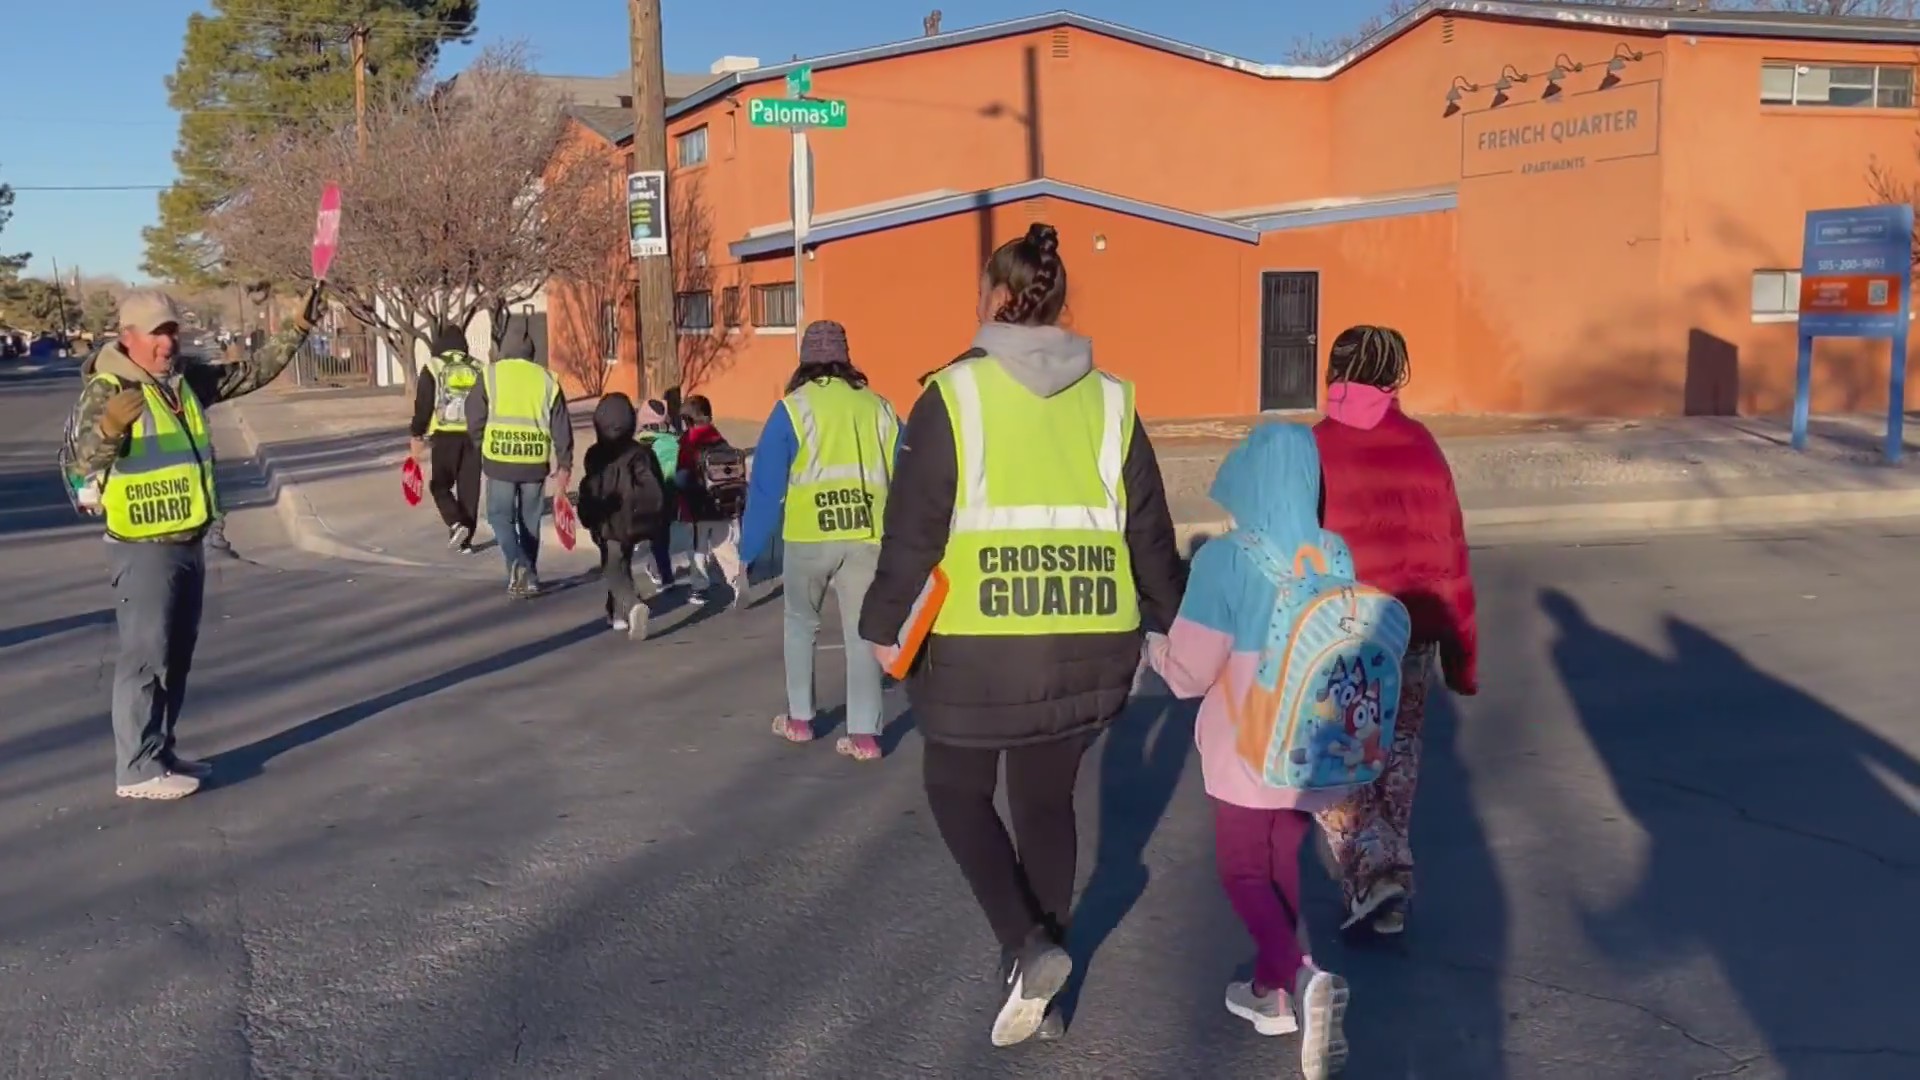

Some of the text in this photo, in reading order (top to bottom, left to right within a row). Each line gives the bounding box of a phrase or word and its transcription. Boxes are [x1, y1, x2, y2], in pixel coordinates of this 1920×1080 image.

[751, 99, 845, 124] Palomas Dr
[1478, 109, 1638, 150] FRENCH QUARTER
[1521, 156, 1586, 175] APARTMENTS
[490, 429, 545, 442] CROSSING
[490, 441, 544, 456] GUARD
[125, 476, 190, 501] CROSSING
[128, 495, 192, 526] GUARD
[979, 544, 1117, 573] CROSSING
[979, 575, 1118, 618] GUARD
